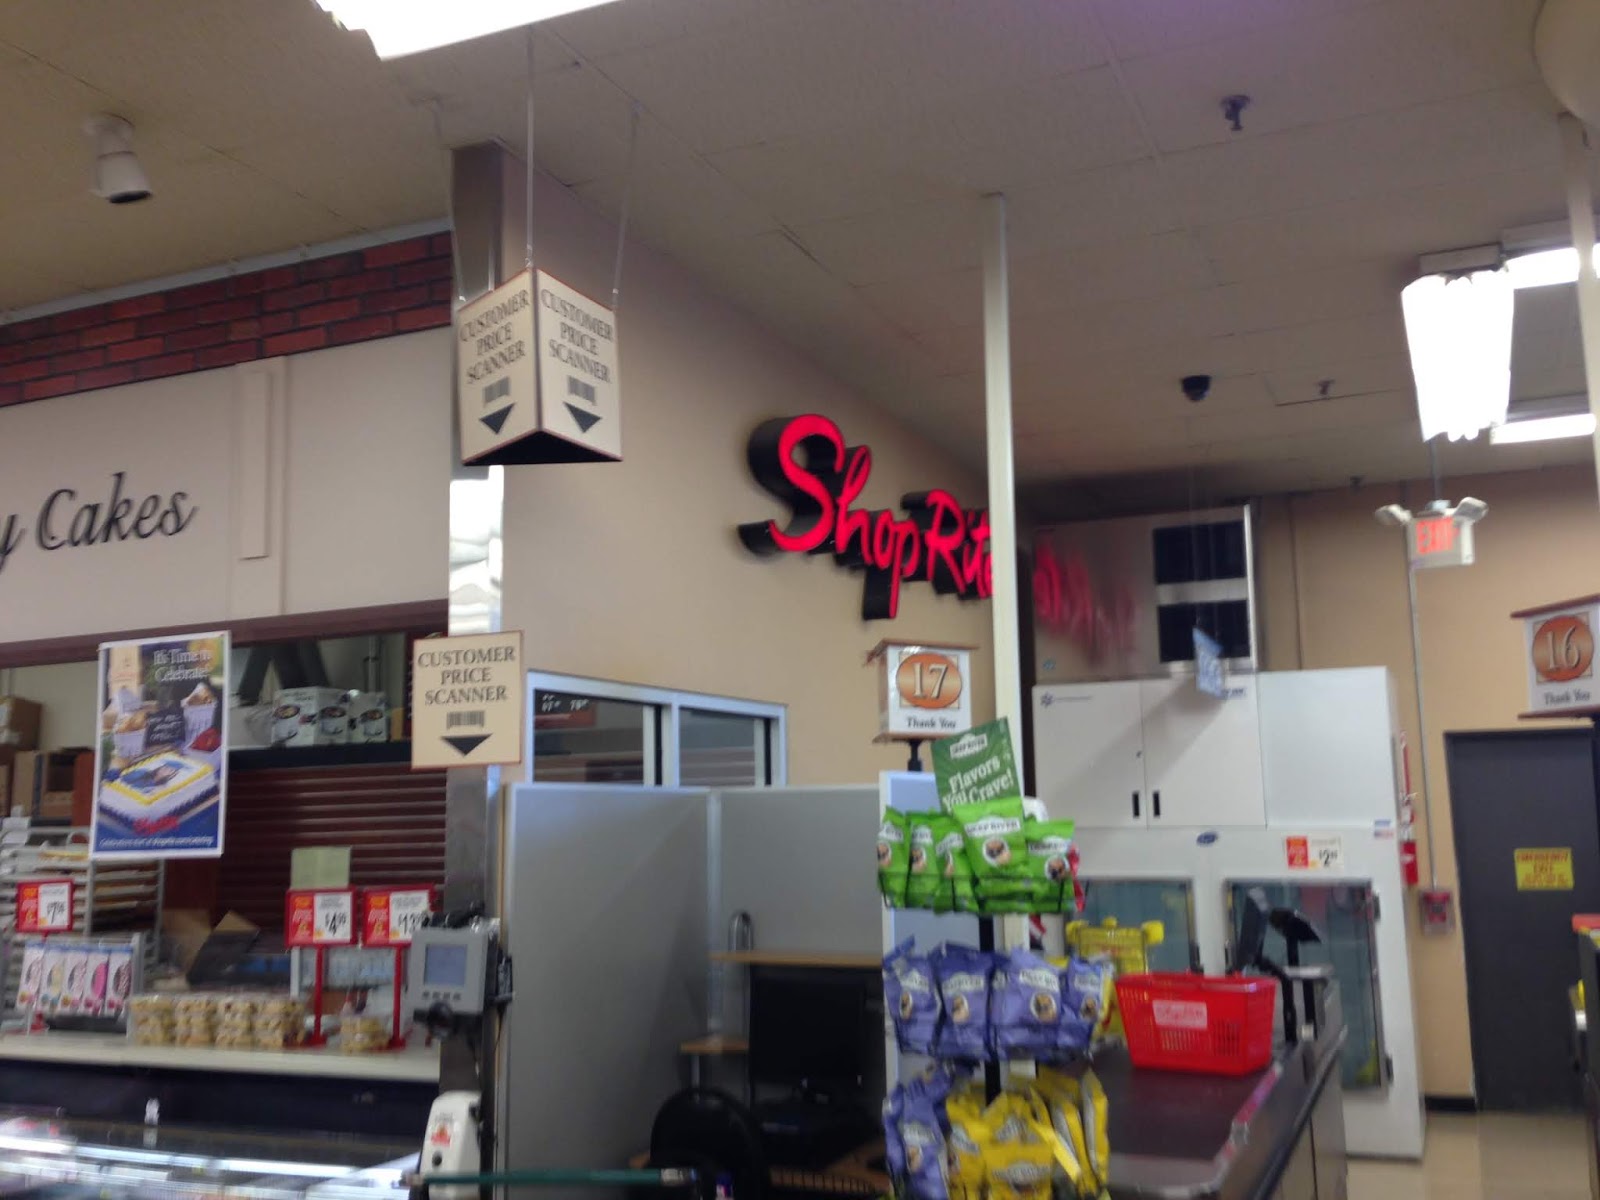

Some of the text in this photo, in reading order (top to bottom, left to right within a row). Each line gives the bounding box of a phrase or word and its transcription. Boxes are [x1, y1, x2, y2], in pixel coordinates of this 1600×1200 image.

[460, 289, 530, 342] CUSTOMER
[541, 289, 614, 341] CUSTOMER
[476, 322, 513, 355] PRICE
[560, 322, 599, 356] PRICE
[466, 340, 527, 384] SCANNER
[550, 339, 611, 384] SCANNER
[36, 471, 199, 551] Cakes
[1415, 516, 1454, 553] EXIT
[417, 646, 516, 668] CUSTOMER
[1546, 625, 1581, 671] 16
[441, 667, 492, 685] PRICE
[912, 662, 949, 699] 17
[424, 685, 507, 705] SCANNER
[1544, 689, 1591, 705] Thank You
[906, 716, 957, 729] Thank You
[949, 756, 1001, 794] Flavors
[968, 768, 1014, 805] Crave!
